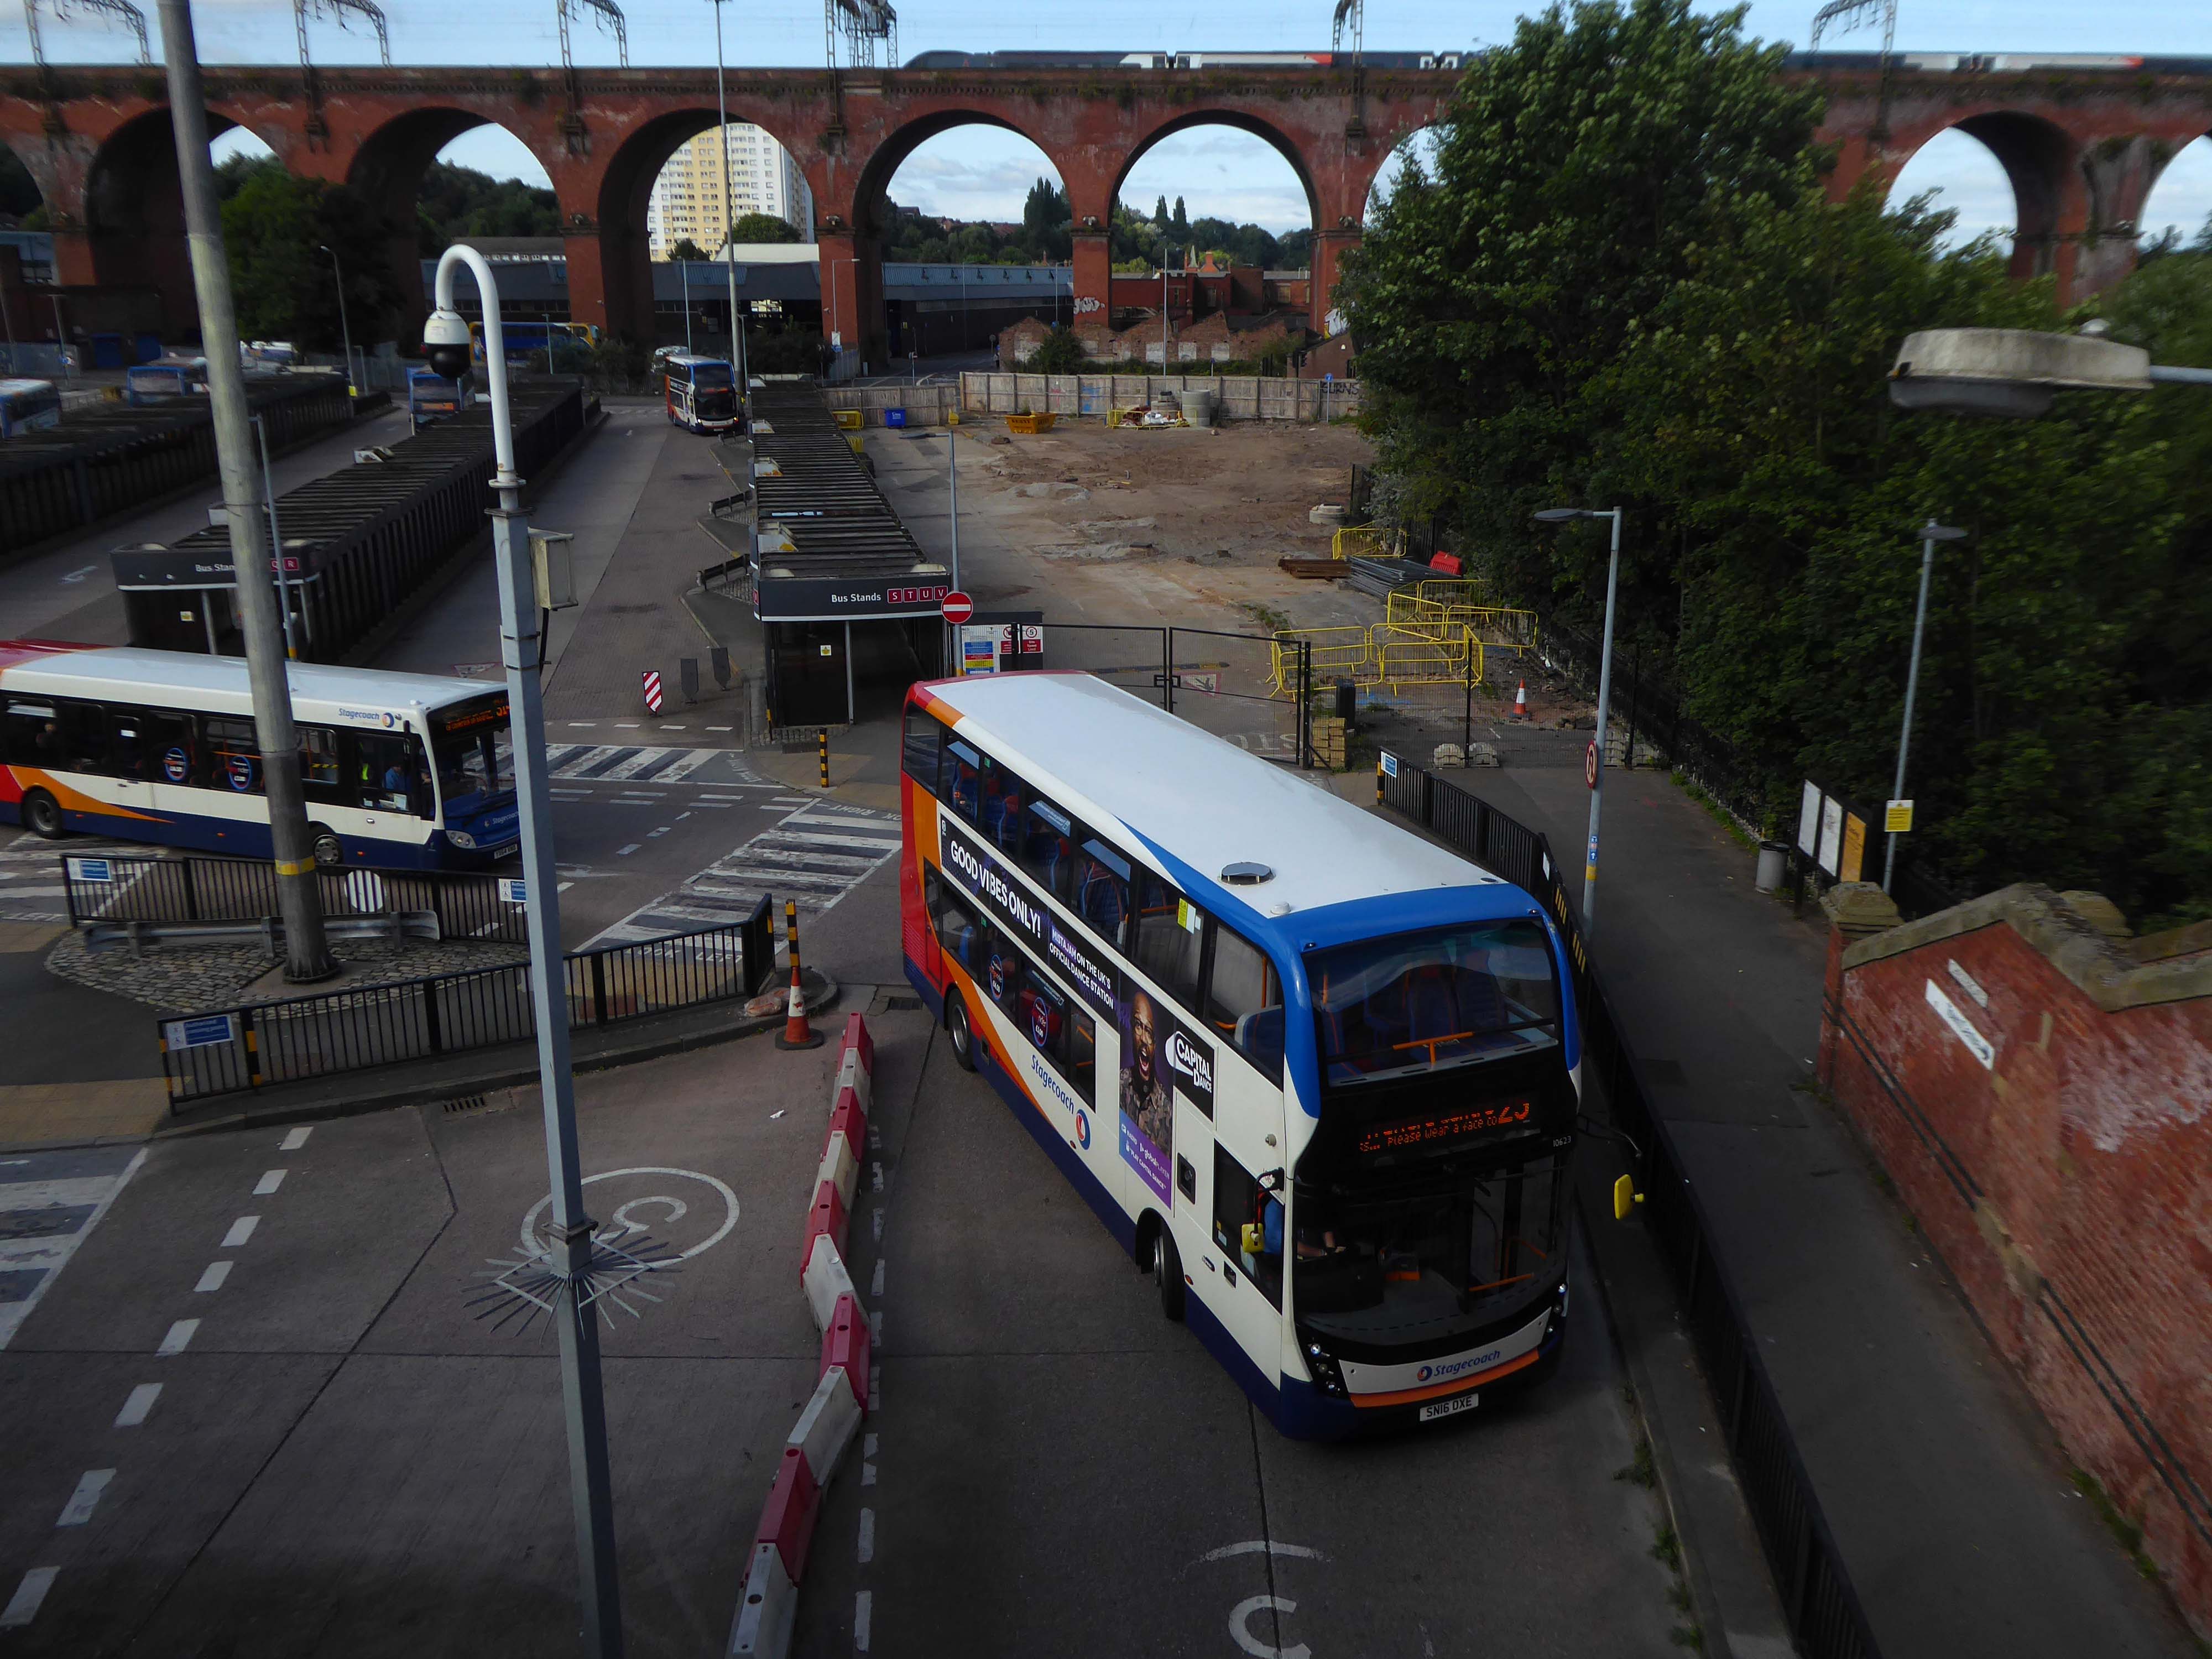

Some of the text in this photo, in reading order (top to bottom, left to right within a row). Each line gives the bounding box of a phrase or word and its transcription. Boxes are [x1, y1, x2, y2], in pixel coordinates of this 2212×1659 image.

[196, 564, 212, 572] Bus
[214, 563, 236, 571] Stan
[831, 594, 848, 603] Bus
[851, 592, 881, 602] Stands
[892, 592, 898, 601] S
[907, 591, 914, 599] T
[923, 589, 929, 598] U
[338, 708, 380, 719] Stagecoach
[830, 804, 877, 816] RIGHT
[951, 840, 1041, 938] GOOD VIBES ONLY!
[1052, 928, 1111, 990] MISTAJAM ON THE UK'S
[1049, 942, 1071, 971] OFFICIAL
[1071, 963, 1090, 988] DANCE
[1090, 979, 1114, 1010] STATION
[1176, 1039, 1212, 1082] CAPITAL
[1031, 1055, 1074, 1114] Stagecoach
[1193, 1067, 1212, 1093] DANCE
[1553, 1135, 1571, 1147] 10623
[1434, 1350, 1500, 1376] Stagecoach
[1426, 1402, 1449, 1417] SN16
